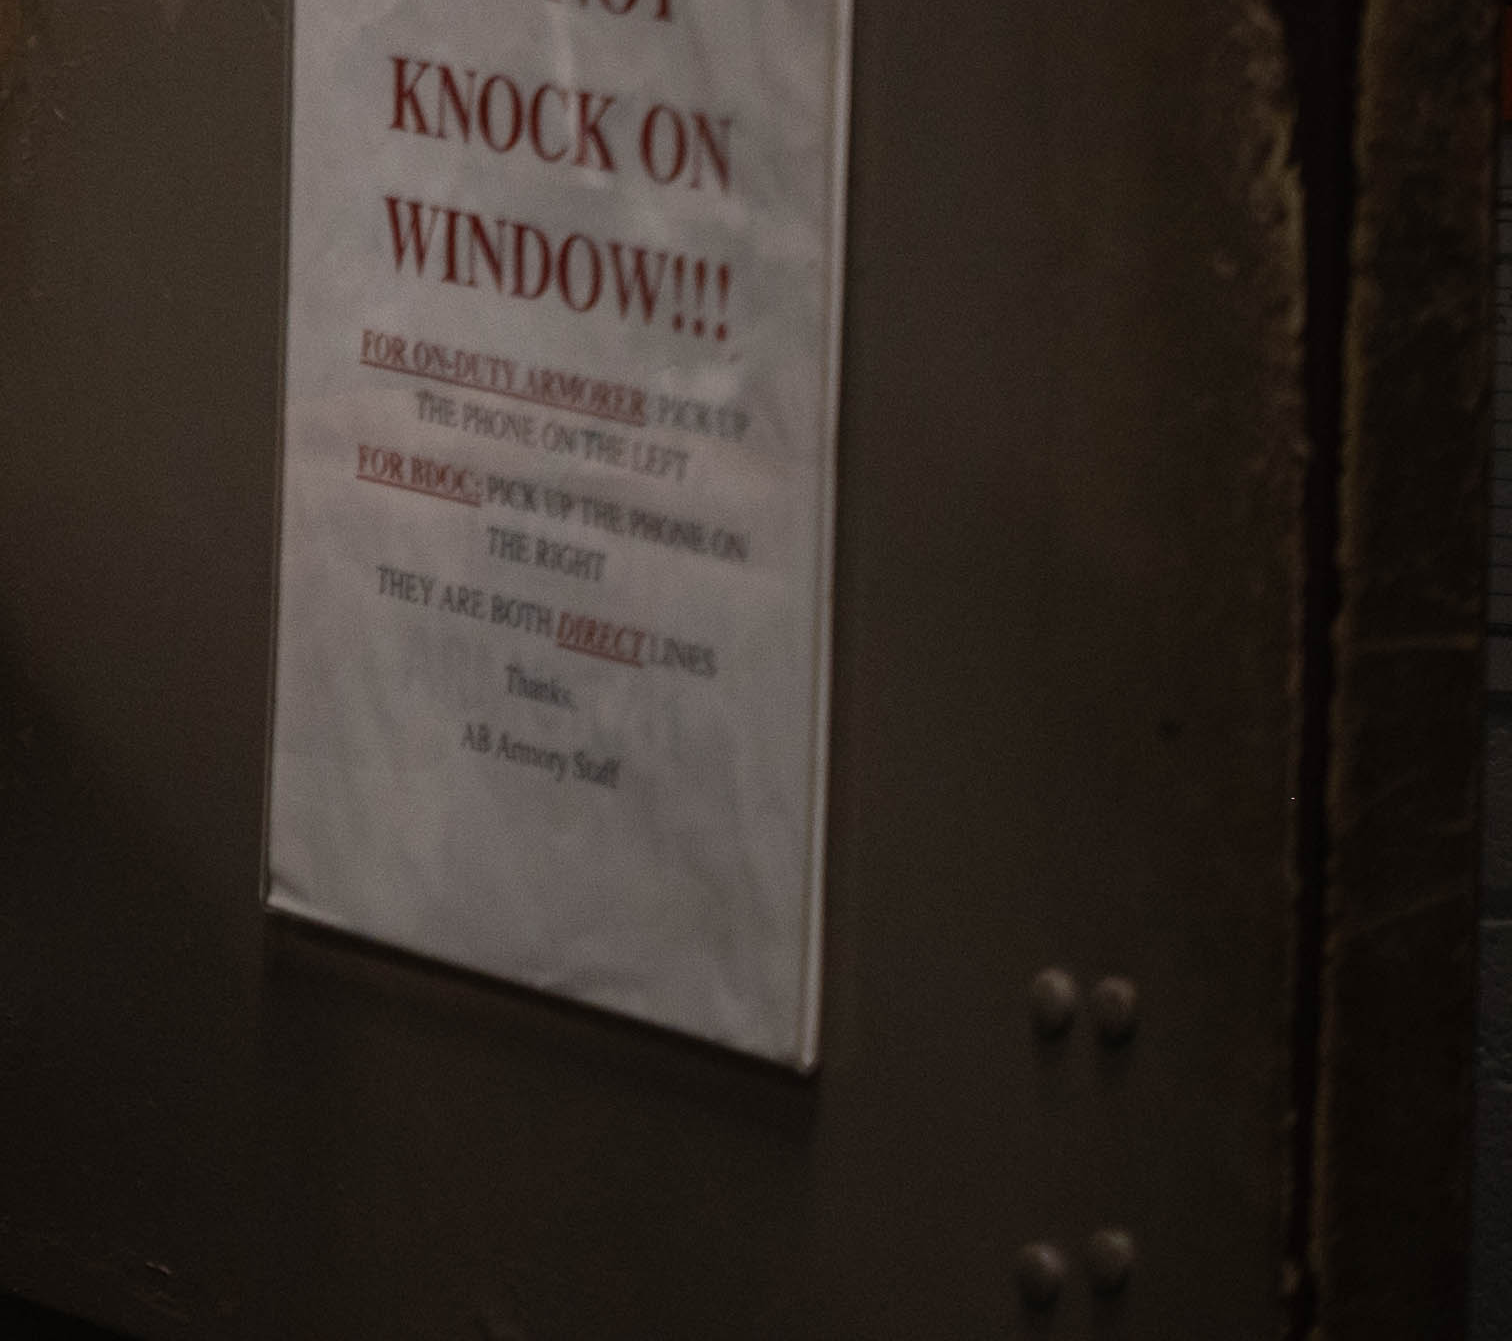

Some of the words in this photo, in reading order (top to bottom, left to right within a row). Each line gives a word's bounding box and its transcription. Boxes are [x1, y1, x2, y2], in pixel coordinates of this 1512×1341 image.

[389, 55, 619, 173] KNOCK
[640, 104, 733, 194] ON
[384, 197, 731, 343] WINDOW!!!
[361, 328, 407, 362] FOR
[413, 340, 517, 391] ON-DUTY
[416, 389, 455, 426] THE
[462, 403, 537, 447] PHONE
[542, 421, 578, 454] ON
[579, 428, 626, 467] THE
[631, 441, 689, 483] LEFT
[357, 443, 404, 478] FOR
[487, 474, 539, 513] PICK
[544, 488, 574, 520] UP
[581, 496, 623, 534] THE
[629, 508, 708, 556] PHONE
[712, 527, 750, 564] ON
[487, 525, 529, 564] THE
[535, 537, 605, 582] RIGHT
[376, 564, 435, 606] THEY
[440, 585, 485, 619] ARE
[491, 594, 552, 637] BOTH
[556, 611, 646, 664] DIRECT
[648, 634, 717, 680] LINES
[497, 731, 567, 782] Armory
[573, 749, 621, 789] Staff
